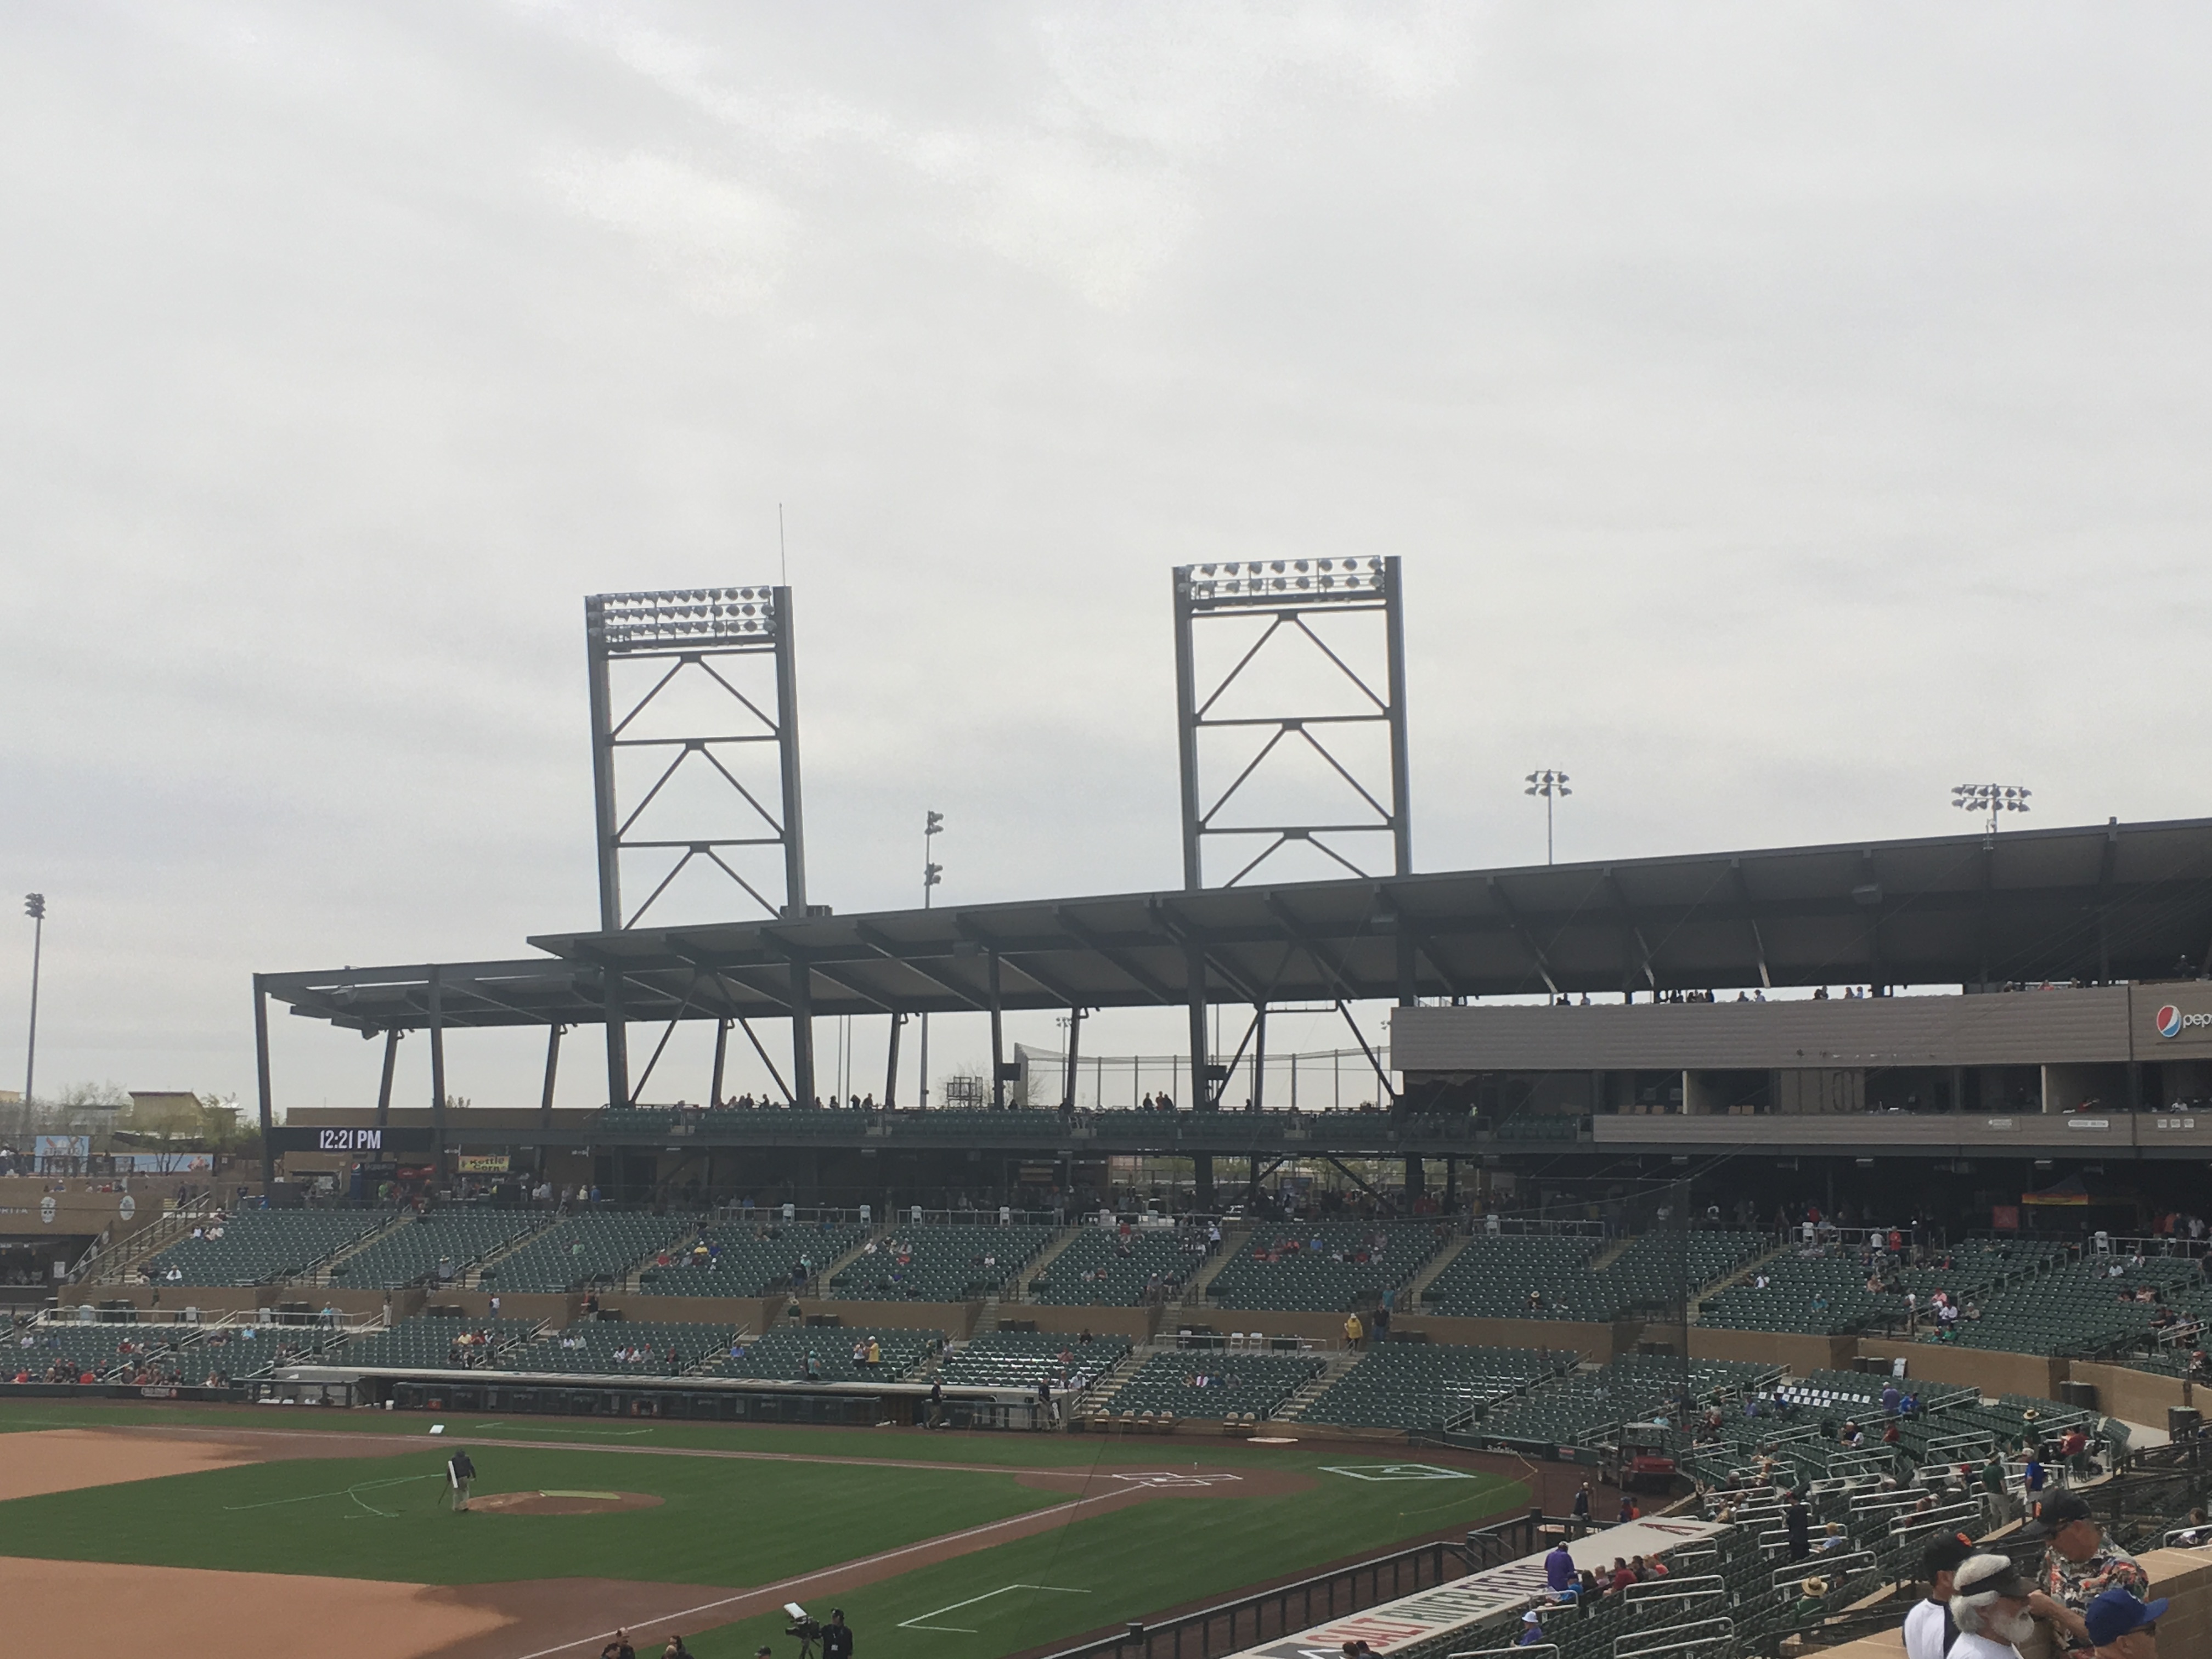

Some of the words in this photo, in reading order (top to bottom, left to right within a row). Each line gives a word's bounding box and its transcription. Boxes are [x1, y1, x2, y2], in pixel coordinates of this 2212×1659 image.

[2183, 1013, 2212, 1029] pep
[320, 1130, 353, 1149] 12:21
[357, 1130, 381, 1149] PM
[1305, 1617, 1435, 1647] SALT
[1375, 1591, 1515, 1623] RIVER
